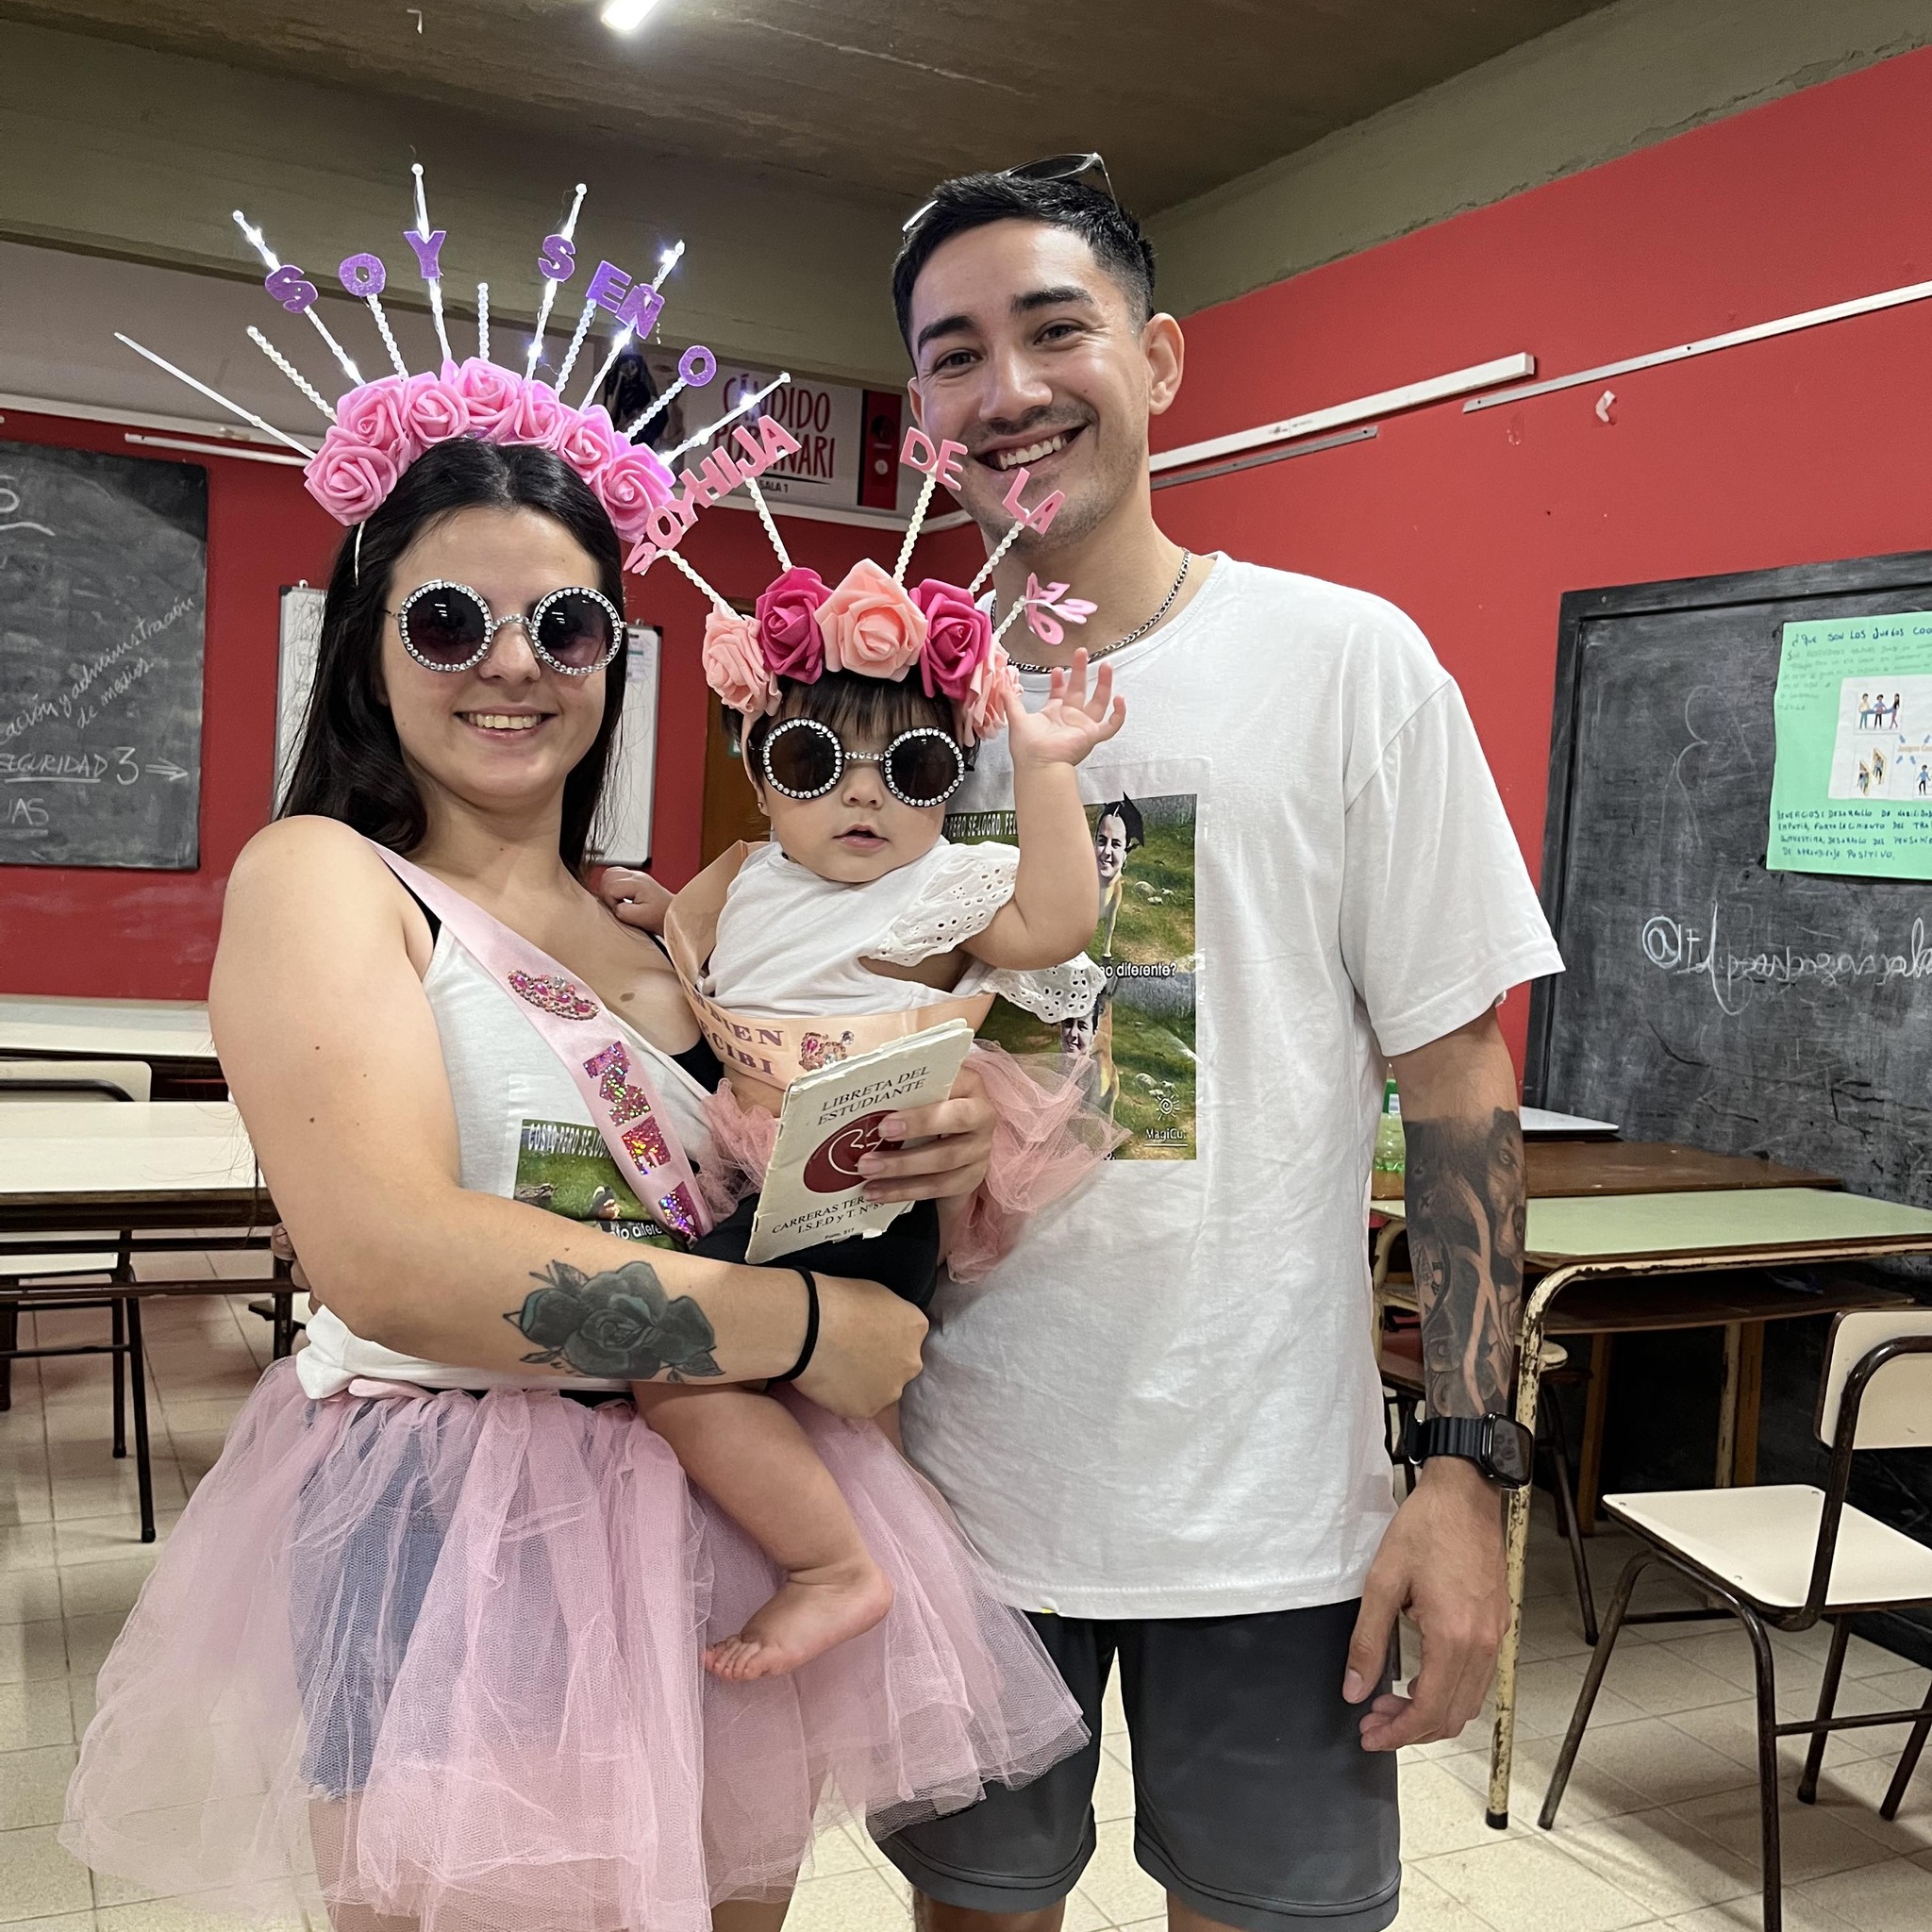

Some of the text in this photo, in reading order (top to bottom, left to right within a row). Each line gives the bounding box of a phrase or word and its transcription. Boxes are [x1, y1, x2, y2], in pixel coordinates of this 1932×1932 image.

[1850, 629, 1867, 640] LOS
[114, 746, 140, 786] 3
[1116, 961, 1177, 977] diferente?
[817, 1077, 926, 1125] ESTUDIANTE
[822, 1066, 930, 1111] LIBRETA DEL
[772, 1204, 840, 1234] CARRERAS
